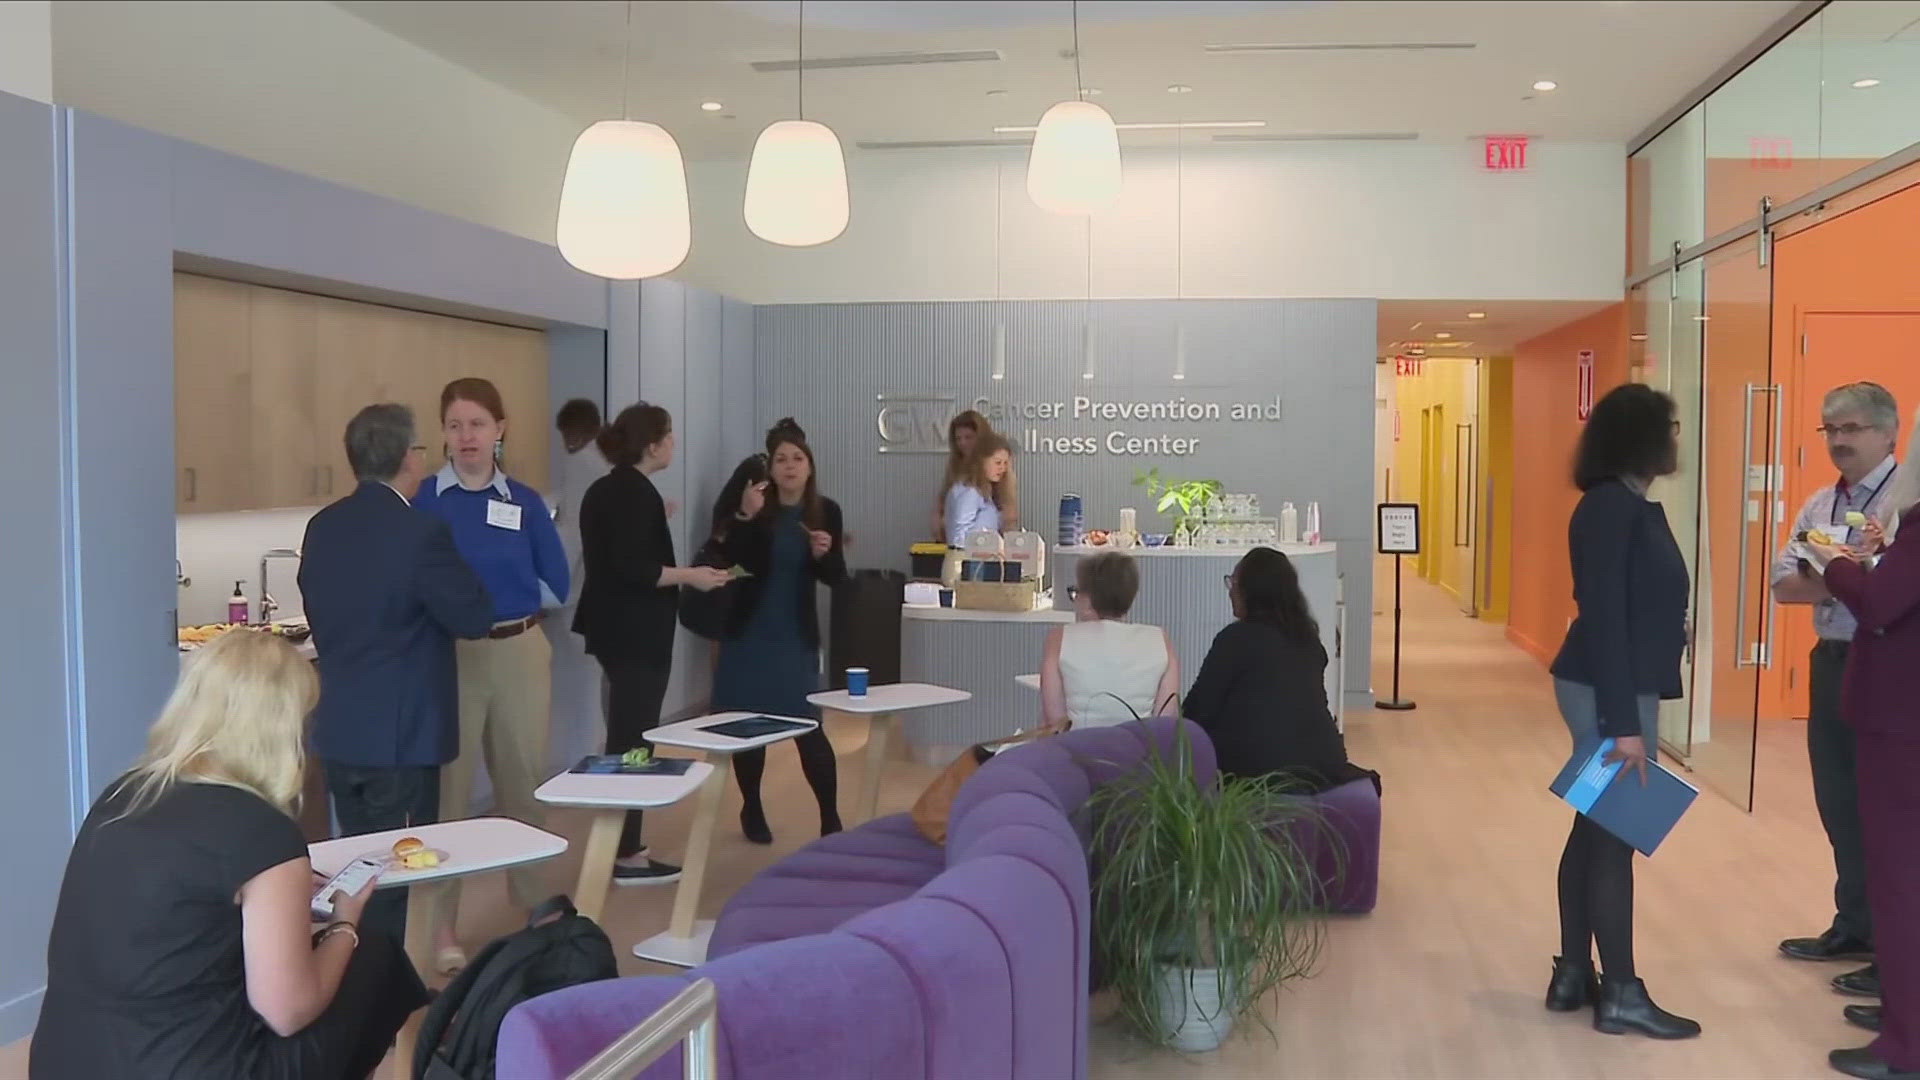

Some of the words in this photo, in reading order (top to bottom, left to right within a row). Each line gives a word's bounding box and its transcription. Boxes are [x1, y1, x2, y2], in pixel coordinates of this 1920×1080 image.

[1486, 140, 1528, 168] EXIT
[1396, 357, 1422, 375] EXIT
[972, 397, 1064, 419] Cancer
[1074, 396, 1220, 419] Prevention
[1231, 396, 1281, 419] and
[1010, 429, 1097, 454] llness
[1106, 430, 1200, 454] Center
